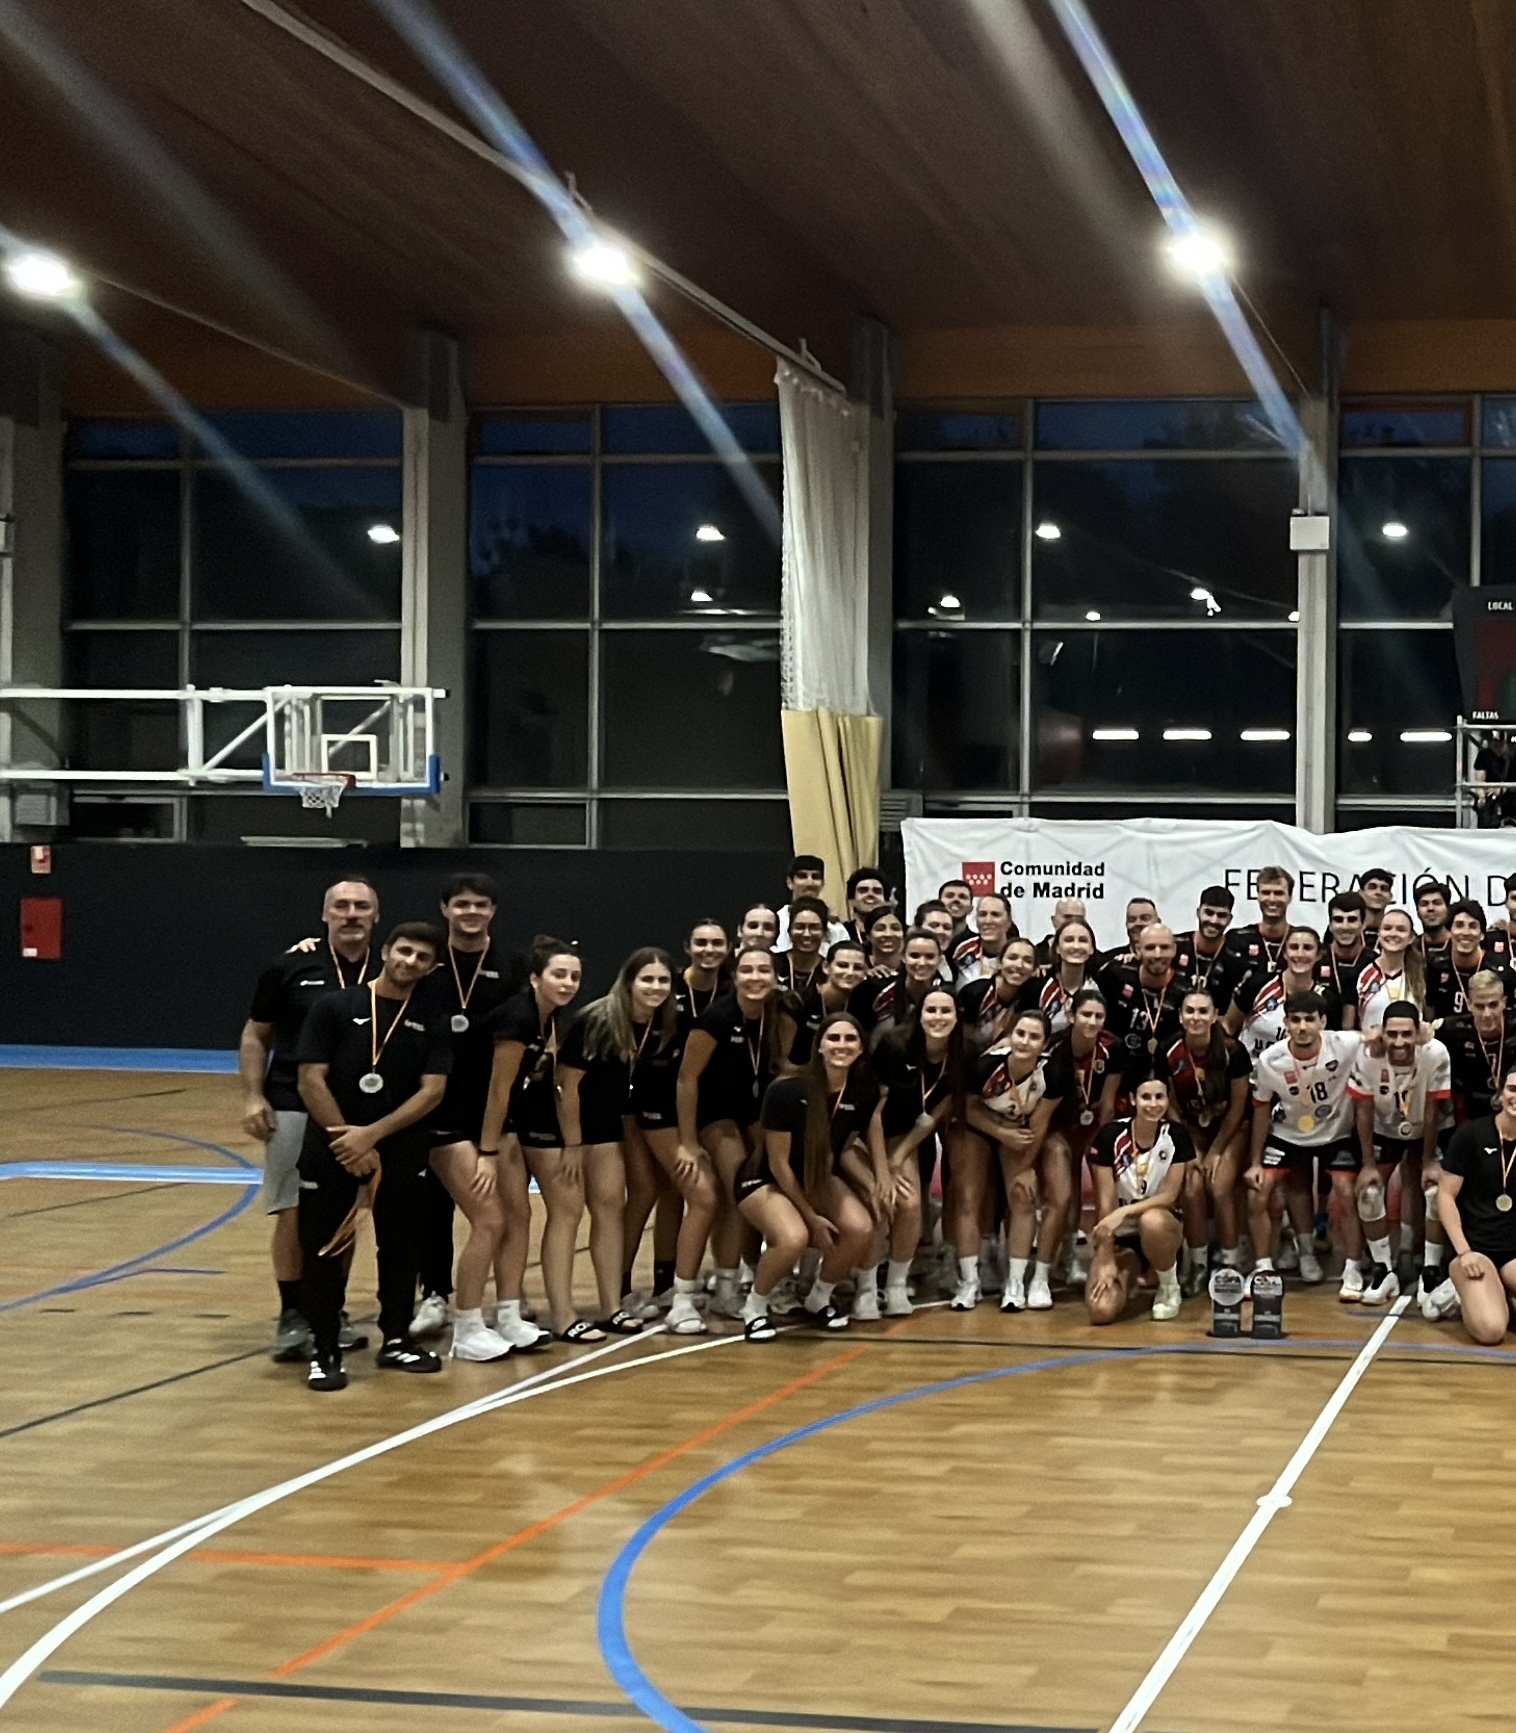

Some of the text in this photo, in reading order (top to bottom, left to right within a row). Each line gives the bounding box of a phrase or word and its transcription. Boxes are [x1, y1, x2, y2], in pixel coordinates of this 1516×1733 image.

[1487, 601, 1514, 611] LOCAL
[1472, 711, 1500, 721] FALTAS
[1000, 861, 1106, 877] Comunidad
[1000, 882, 1105, 899] de Madrid
[1306, 1081, 1329, 1104] 18
